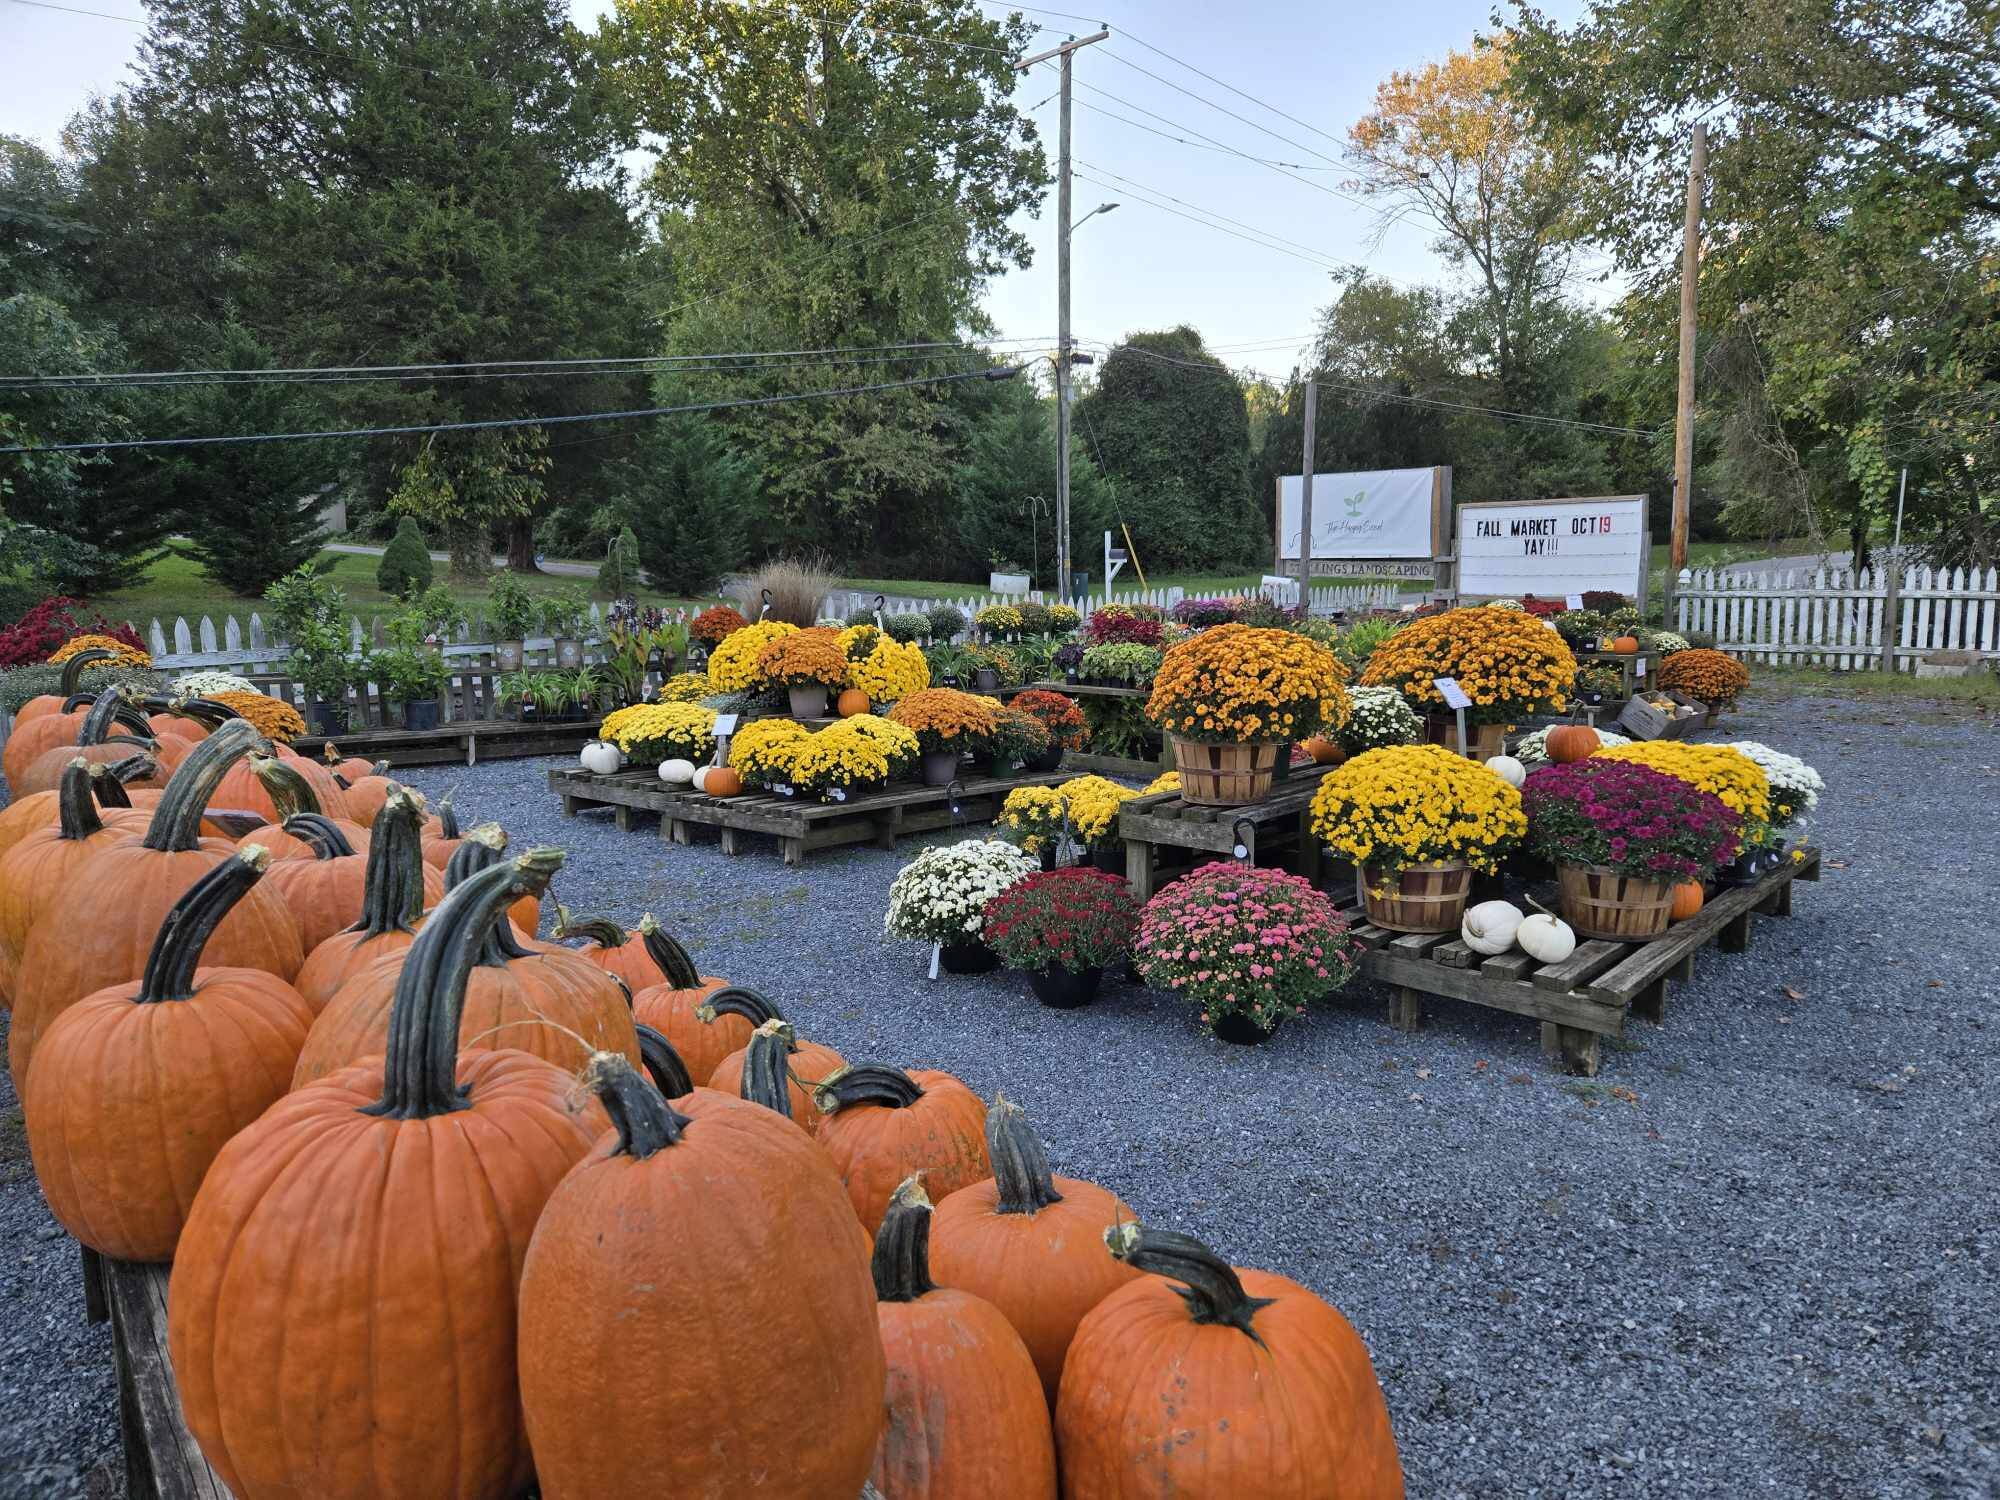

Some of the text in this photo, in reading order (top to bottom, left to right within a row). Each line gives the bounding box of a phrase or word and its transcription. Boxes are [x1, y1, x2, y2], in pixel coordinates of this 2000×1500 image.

[1477, 516, 1611, 537] FALL MARKET OCT 19
[1524, 538, 1558, 556] YAY!!!
[1351, 563, 1430, 576] LANDSCAPING
